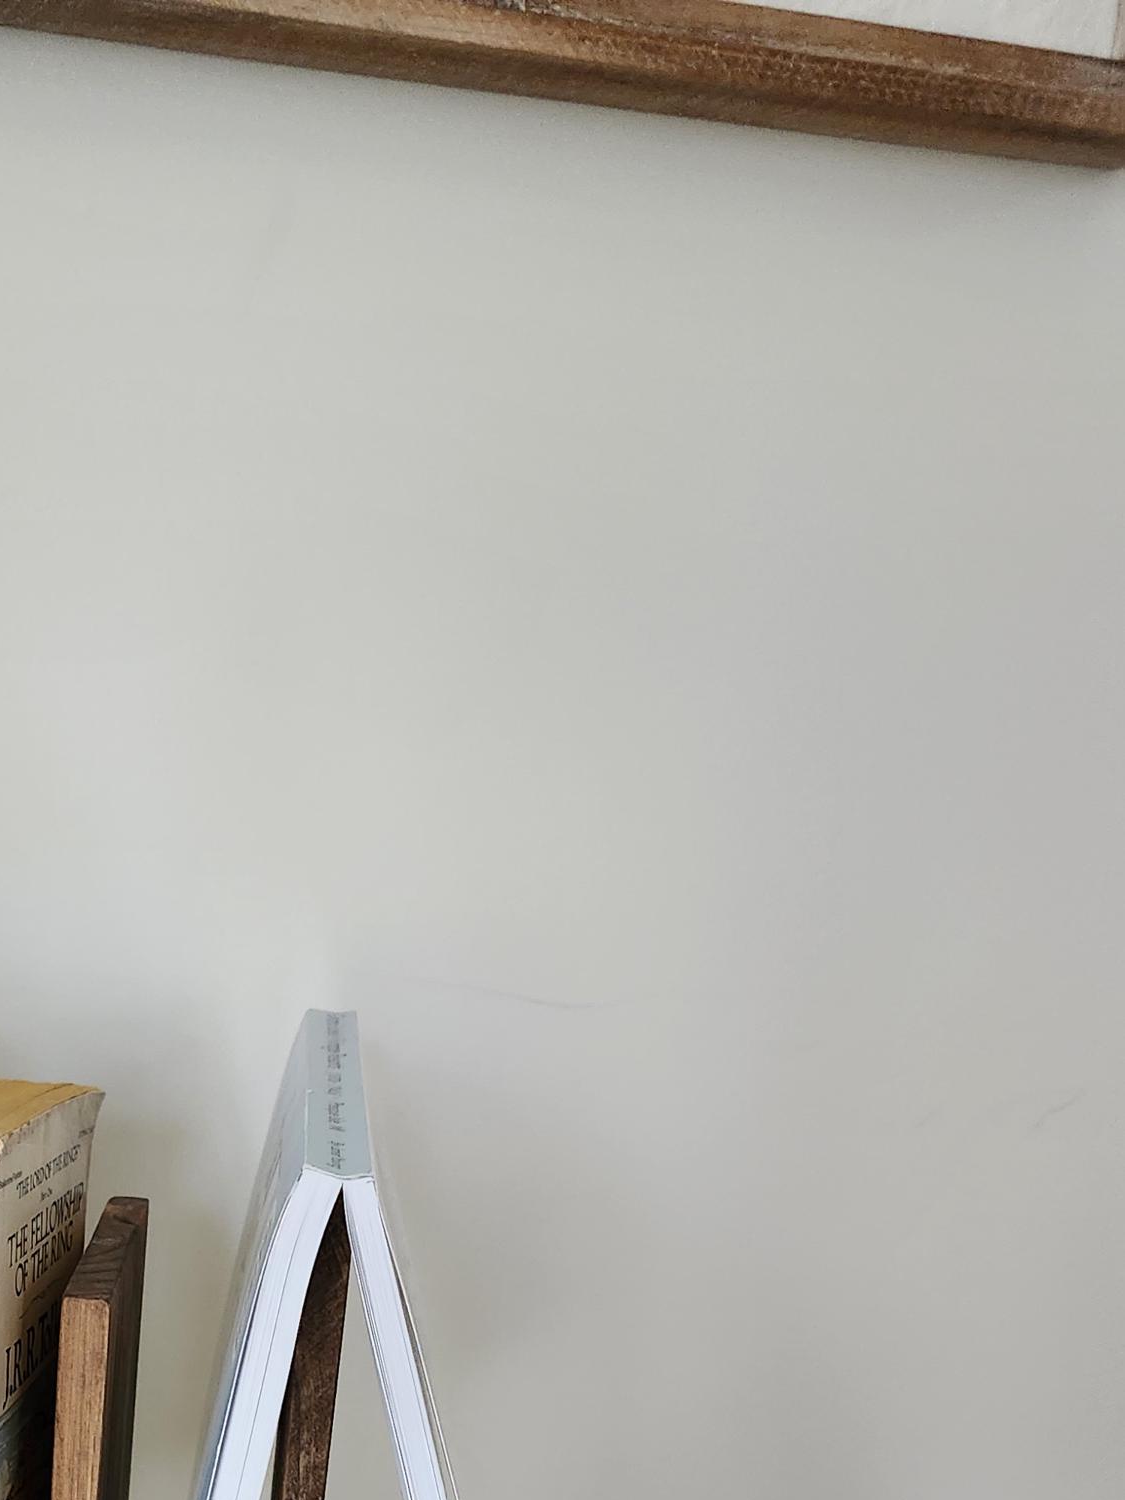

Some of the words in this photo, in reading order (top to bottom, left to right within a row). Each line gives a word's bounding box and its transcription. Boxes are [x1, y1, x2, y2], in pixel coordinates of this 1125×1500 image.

[7, 1223, 28, 1268] THE
[30, 1182, 84, 1250] FELLOWSHIP
[15, 1259, 29, 1297] OF
[31, 1241, 50, 1283] THE
[50, 1220, 74, 1266] RING
